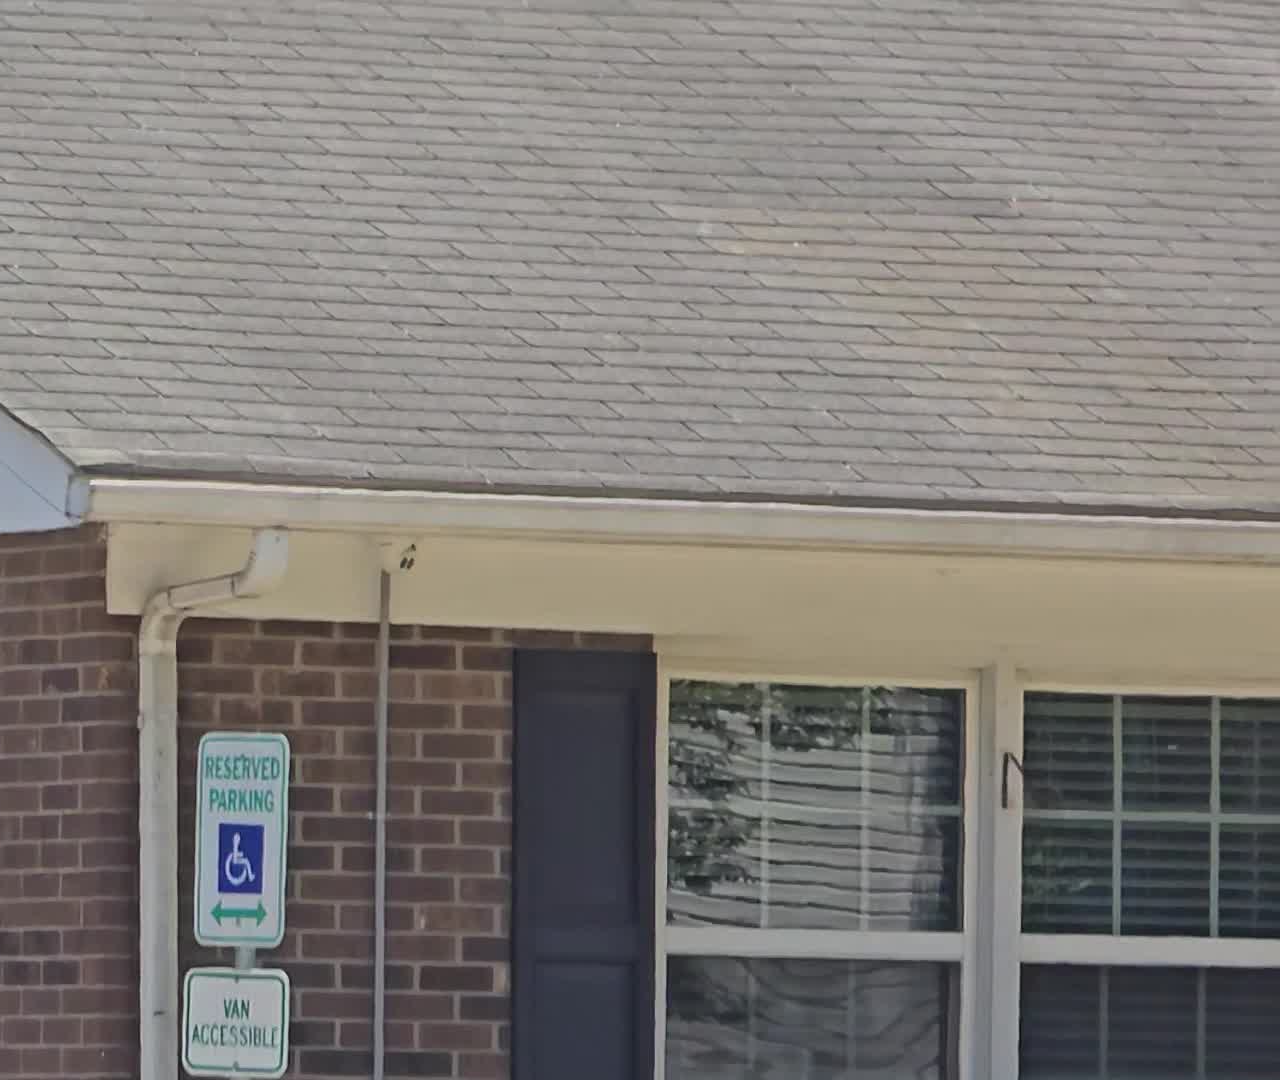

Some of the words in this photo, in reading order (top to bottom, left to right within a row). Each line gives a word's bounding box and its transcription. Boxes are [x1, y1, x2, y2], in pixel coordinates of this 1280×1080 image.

[205, 756, 281, 780] RESERVED
[209, 788, 274, 812] PARKING
[223, 997, 250, 1019] VAN
[192, 1023, 280, 1047] ACCESSIBLE
